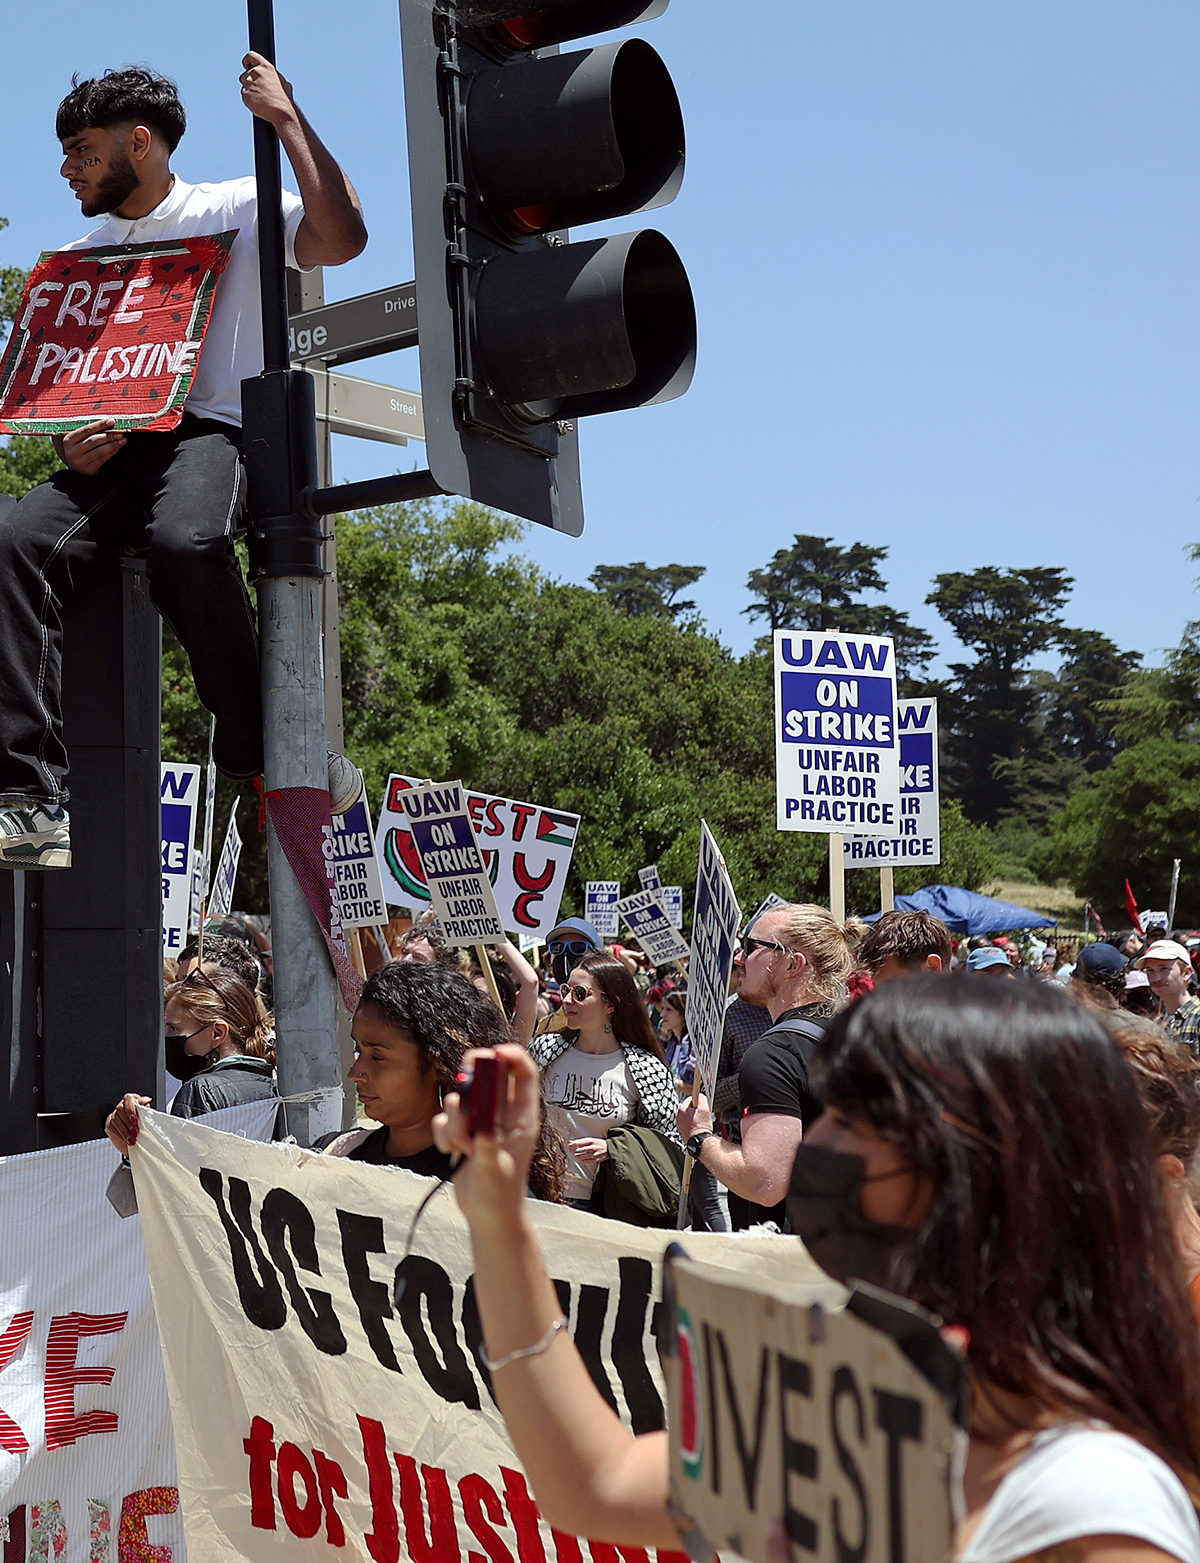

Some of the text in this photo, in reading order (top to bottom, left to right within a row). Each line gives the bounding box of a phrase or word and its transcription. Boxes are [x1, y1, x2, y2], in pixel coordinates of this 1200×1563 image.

[20, 275, 153, 330] FREE
[384, 296, 416, 313] Drive
[28, 341, 204, 385] PALESTINE
[390, 399, 417, 416] Street
[781, 638, 889, 671] UAW
[816, 679, 859, 708] ON
[785, 709, 891, 742] STRIKE
[798, 749, 880, 773] UNFAIR
[803, 774, 876, 798] LABOR
[386, 777, 537, 842] DEST
[402, 787, 461, 818] UAW
[785, 798, 894, 825] PRACTICE
[333, 814, 345, 831] N
[430, 822, 457, 847] ON
[336, 863, 367, 881] FAIR
[423, 847, 480, 875] STRIKE
[337, 882, 368, 901] BOR
[437, 877, 483, 899] UNFAIR
[588, 884, 618, 892] UAW
[596, 894, 609, 904] ON
[702, 835, 739, 940] UAW
[340, 899, 382, 920] CTICE
[446, 900, 487, 918] LABOR
[616, 893, 651, 913] UAW
[443, 917, 501, 938] PRACTICE
[633, 917, 669, 937] STRIKE
[635, 910, 652, 923] ON
[706, 904, 721, 956] ON
[651, 939, 676, 951] LABOR
[651, 944, 688, 961] PRACTICE
[695, 913, 725, 1012] STRIKE
[200, 1167, 347, 1356] UC
[677, 1306, 923, 1563] DIVEST
[243, 1416, 348, 1547] for
